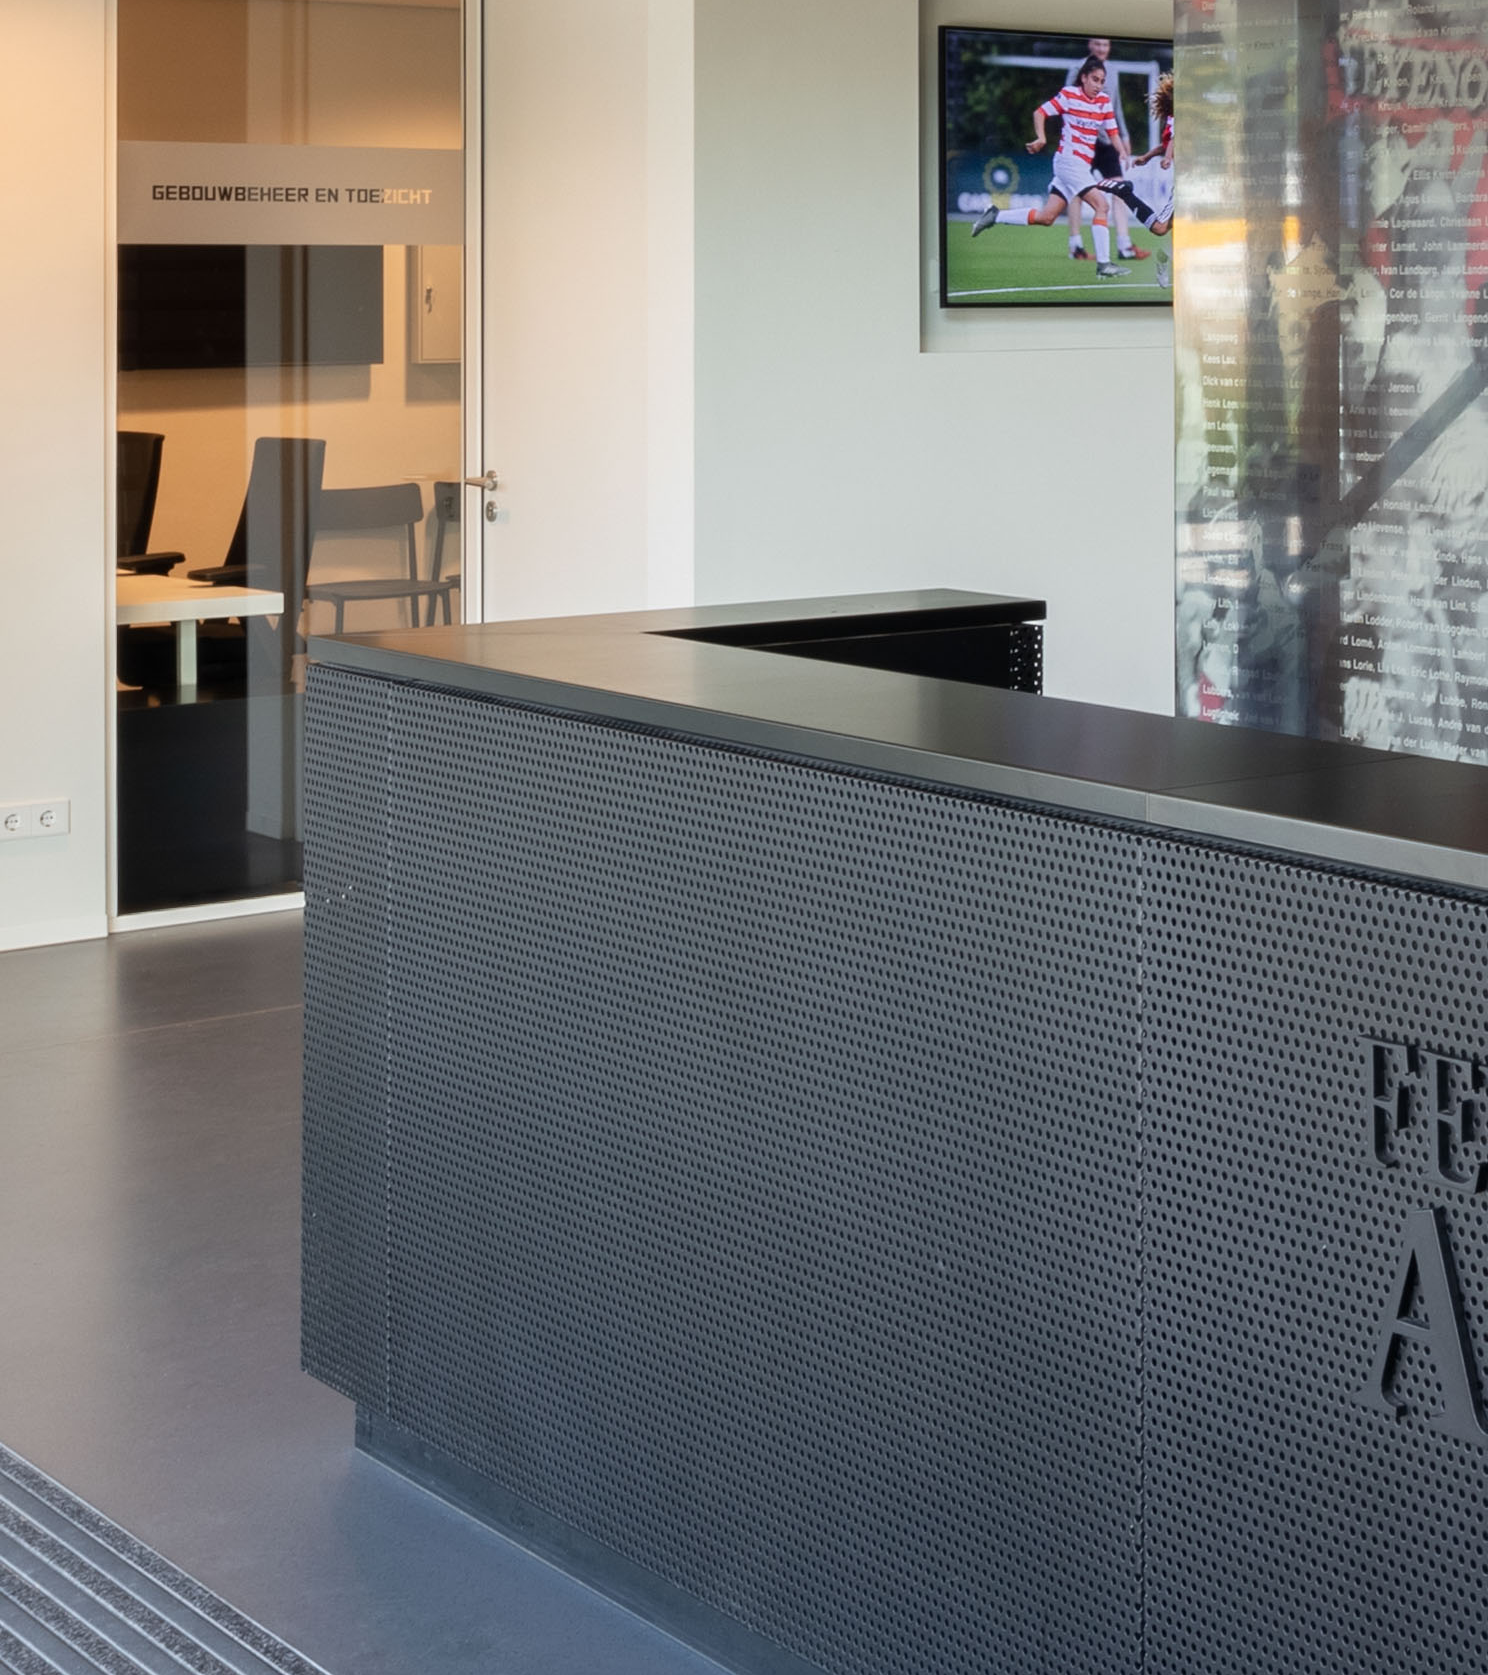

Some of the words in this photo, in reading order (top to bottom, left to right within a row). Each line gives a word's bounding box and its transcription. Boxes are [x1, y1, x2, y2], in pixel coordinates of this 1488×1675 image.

[152, 184, 309, 202] GEBOUWBEHEER
[315, 188, 339, 203] EN
[345, 188, 432, 204] TOEZICHT
